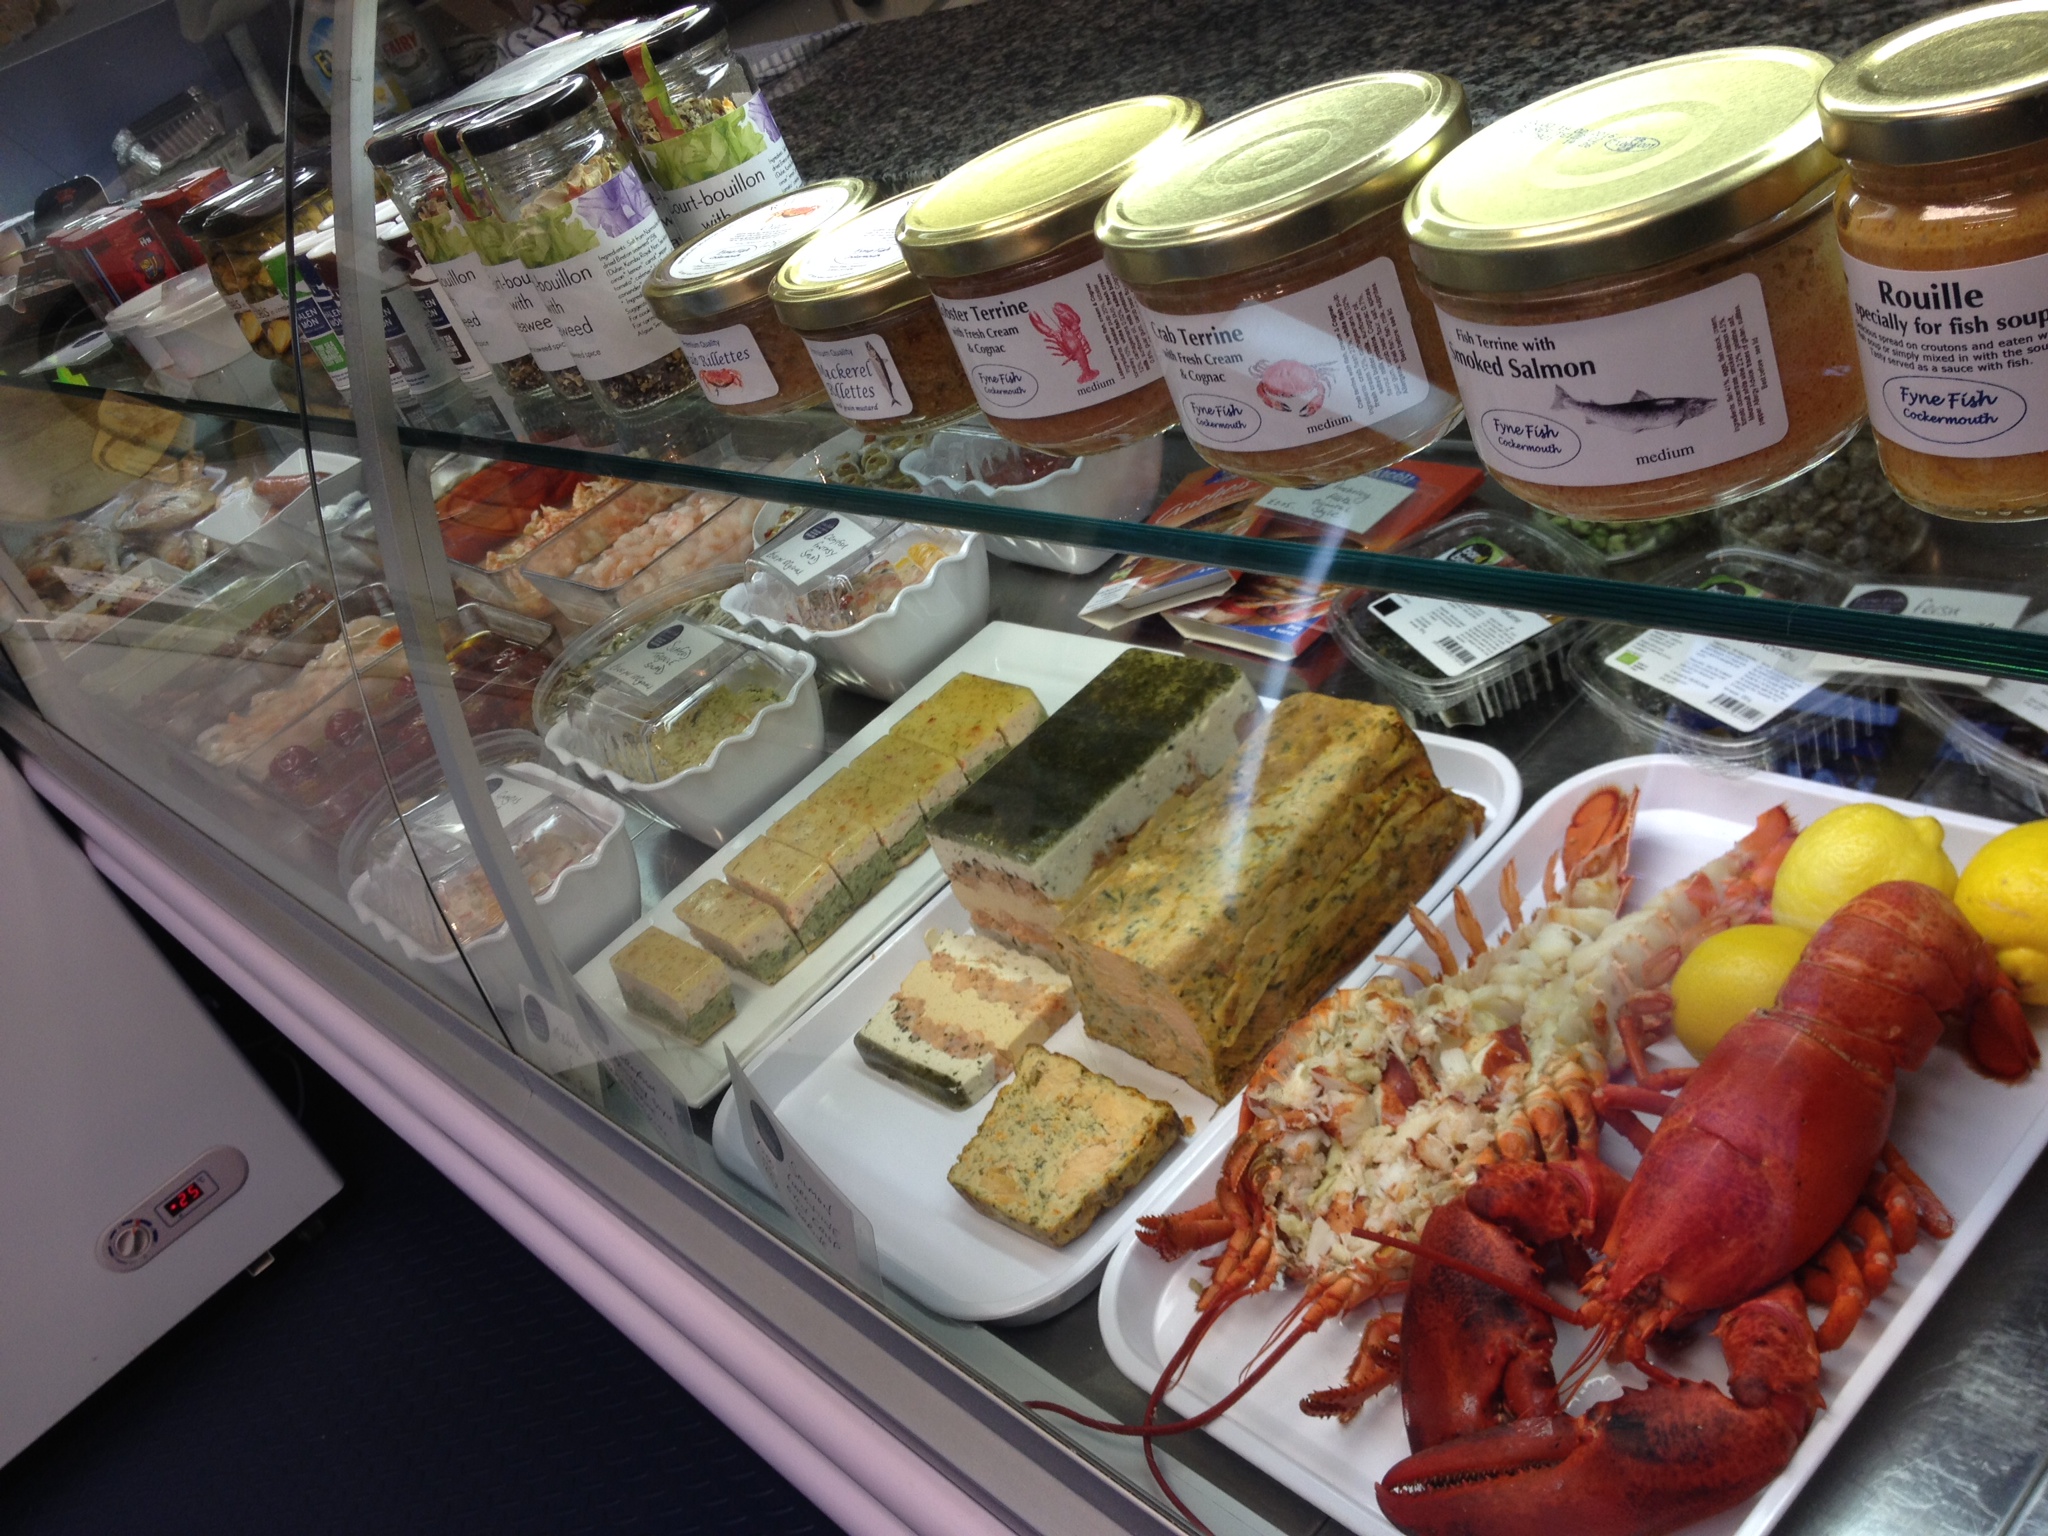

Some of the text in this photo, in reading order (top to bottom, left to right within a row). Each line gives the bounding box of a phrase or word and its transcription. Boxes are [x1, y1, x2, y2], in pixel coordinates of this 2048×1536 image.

[1878, 280, 1984, 310] Rouille
[297, 307, 318, 320] ALEN
[970, 300, 1030, 322] Terrine
[1855, 302, 1908, 337] specially
[1914, 317, 1942, 335] for
[1949, 315, 1989, 335] fish
[516, 316, 553, 334] eawee
[964, 328, 986, 339] Fresh
[986, 325, 1020, 339] Cream
[1150, 321, 1244, 346] Crab Terrine
[1456, 328, 1556, 352] Fish Terrine with
[1879, 334, 1904, 348] spread
[1906, 342, 1918, 350] on
[1921, 343, 1968, 352] croutons
[1972, 340, 1994, 350] and
[1998, 335, 2033, 347] eaten
[699, 347, 751, 368] Rillettes
[975, 343, 1007, 357] Cognac
[1178, 352, 1202, 365] Fresh
[1204, 353, 1244, 366] Cream
[1892, 348, 1919, 362] simply
[1923, 353, 1955, 362] mixed
[1958, 354, 1969, 362] in
[1973, 351, 1998, 361] with
[2002, 349, 2023, 358] the
[2027, 344, 2048, 354] sou
[1449, 341, 1596, 379] Smoked Salmon
[1888, 357, 1915, 370] served
[1918, 364, 1929, 372] as
[1941, 365, 1973, 373] sauce
[1978, 362, 2003, 371] with
[2007, 358, 2034, 368] fish.
[978, 371, 1023, 385] Fyne Fish
[1077, 377, 1116, 396] medium
[1188, 370, 1226, 386] Cognac
[1900, 386, 1998, 409] Fyne Fish
[1190, 402, 1243, 418] Fyne Fish
[1903, 408, 1998, 425] Cockermouth
[1306, 414, 1353, 434] medium
[1493, 418, 1559, 439] Fyne Fish
[1498, 436, 1562, 454] Cockermouth
[1636, 444, 1695, 466] medium
